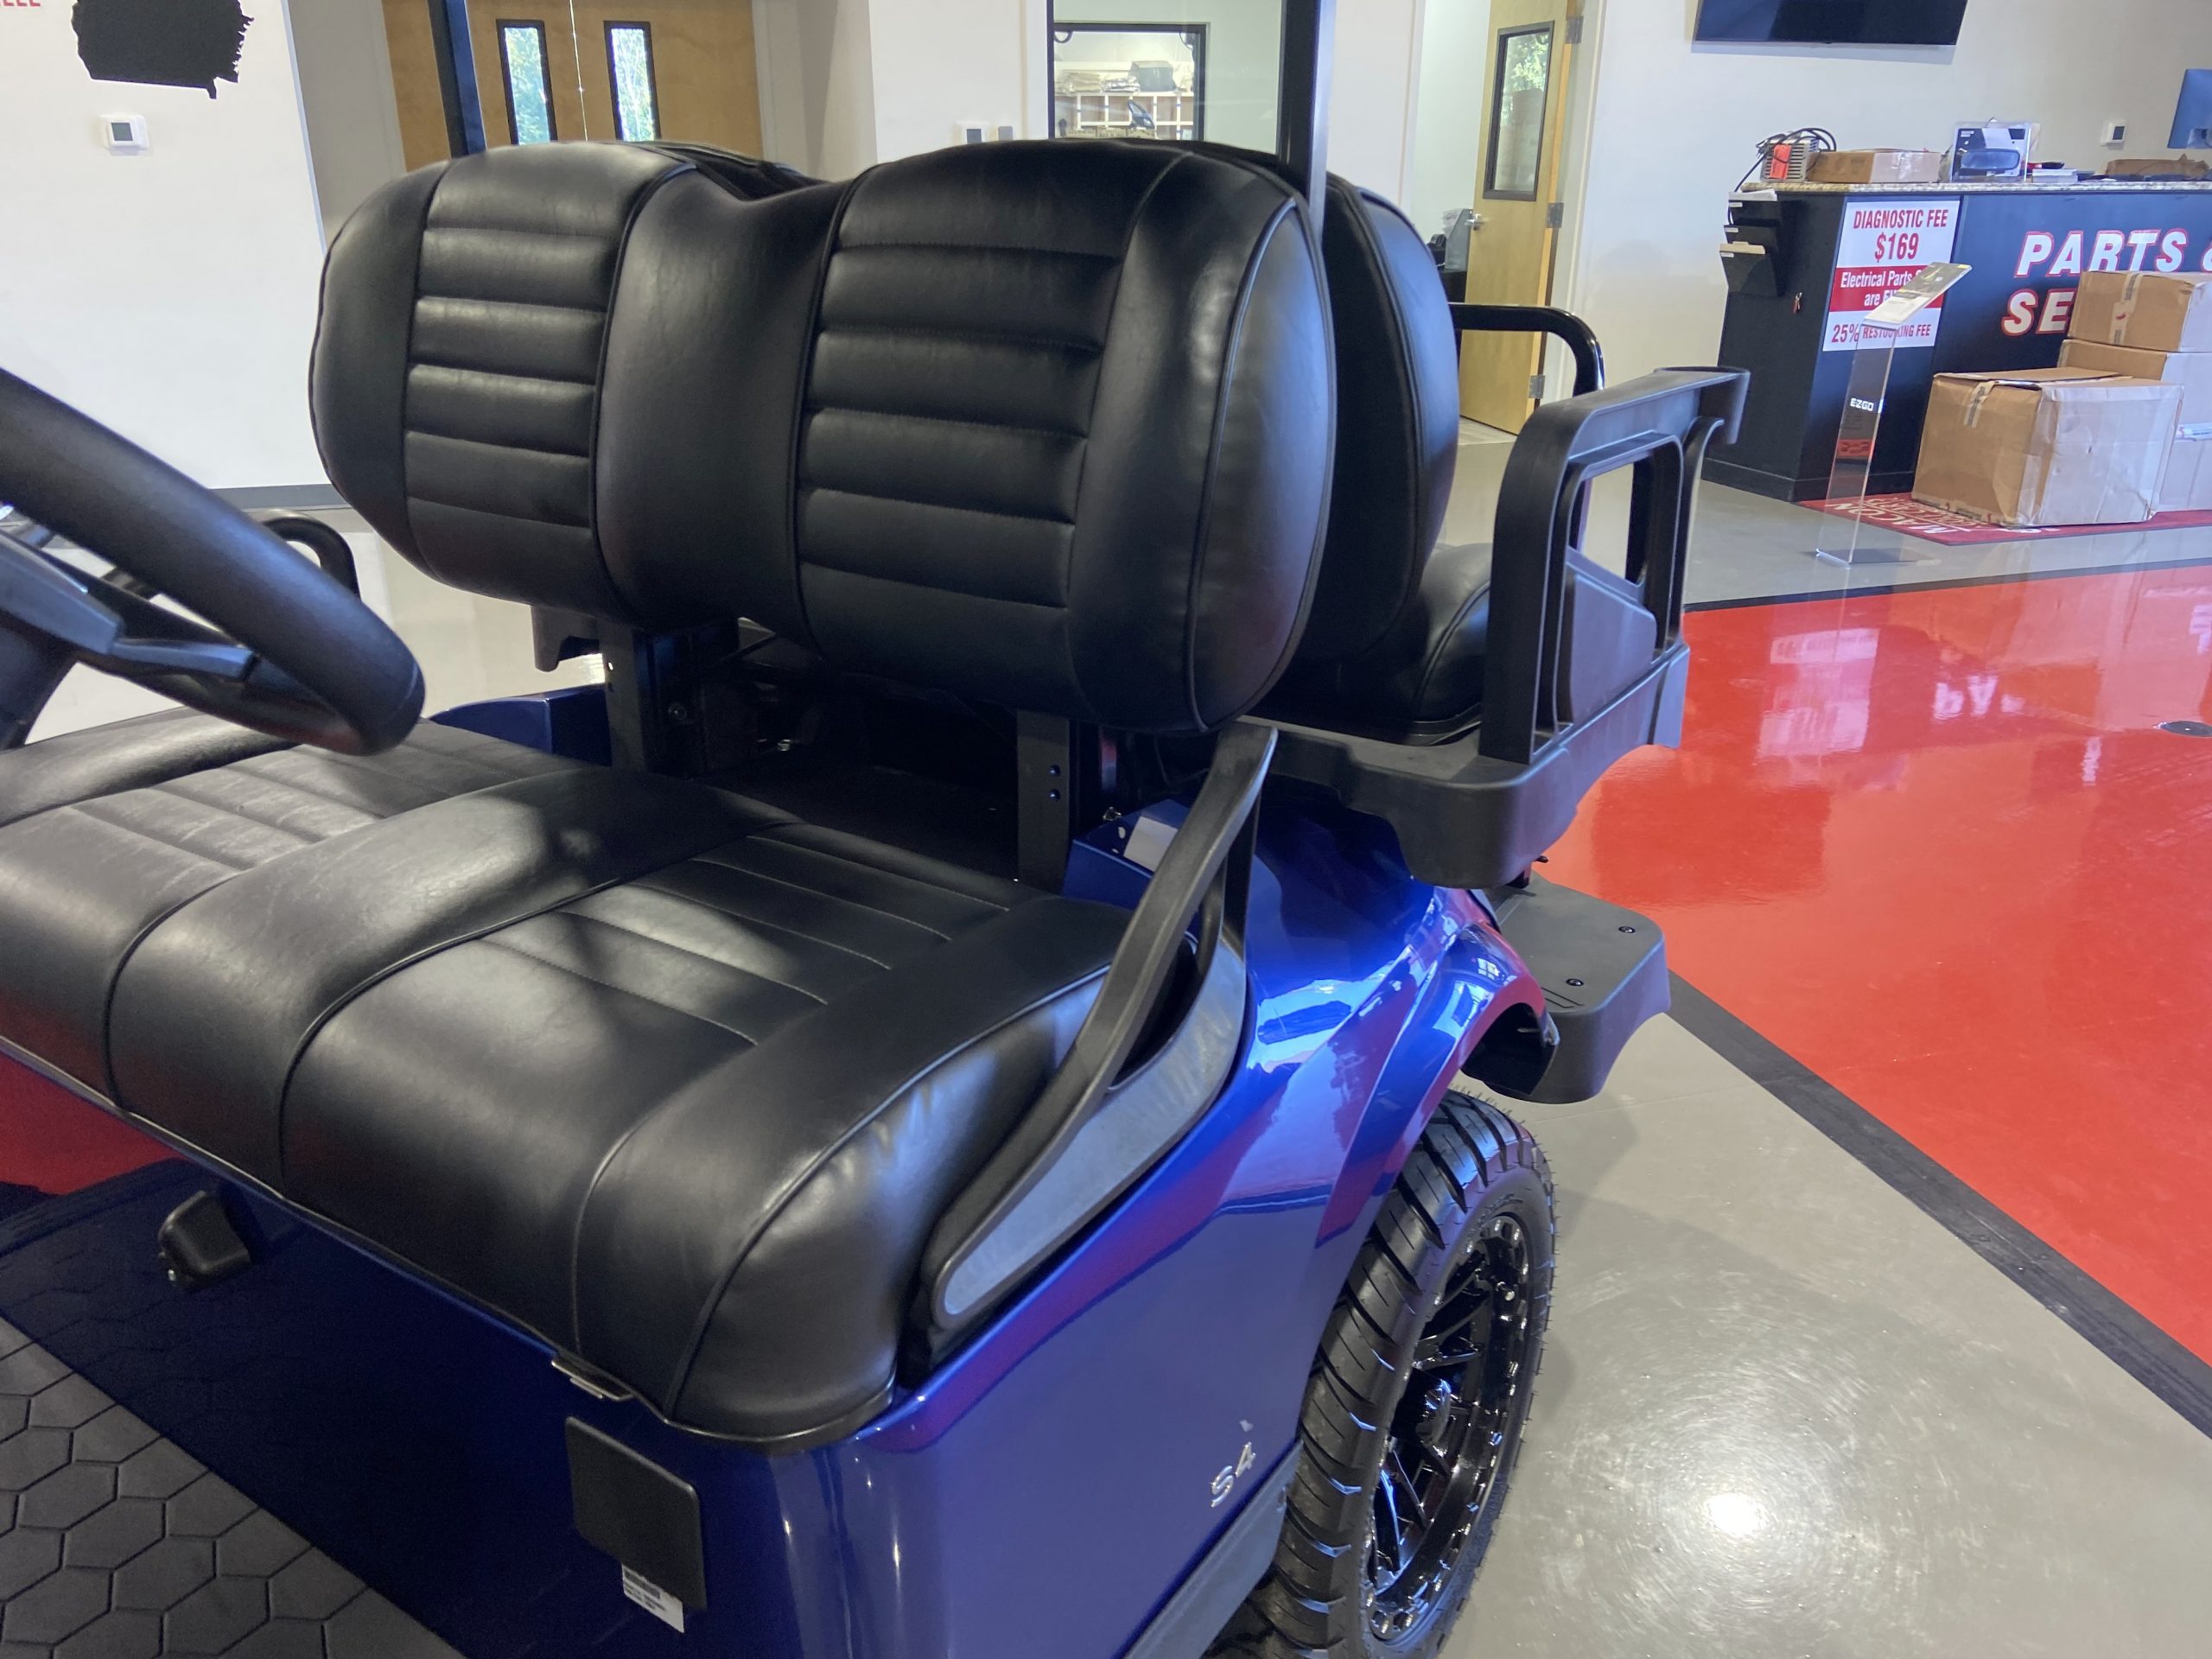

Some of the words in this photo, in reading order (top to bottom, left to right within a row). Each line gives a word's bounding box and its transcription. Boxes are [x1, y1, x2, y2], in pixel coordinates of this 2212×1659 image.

[1853, 209, 1923, 229] DIAGNOSTIC
[1926, 209, 1949, 228] FEE
[1874, 232, 1920, 263] $169
[2015, 228, 2188, 277] PARTS
[1840, 270, 1886, 289] Electrical
[1887, 269, 1912, 287] Parts
[1864, 293, 1880, 307] are
[2001, 288, 2075, 337] SE
[1832, 323, 1860, 343] 25%
[1916, 323, 1932, 338] FEE
[1210, 1441, 1256, 1508] S4
